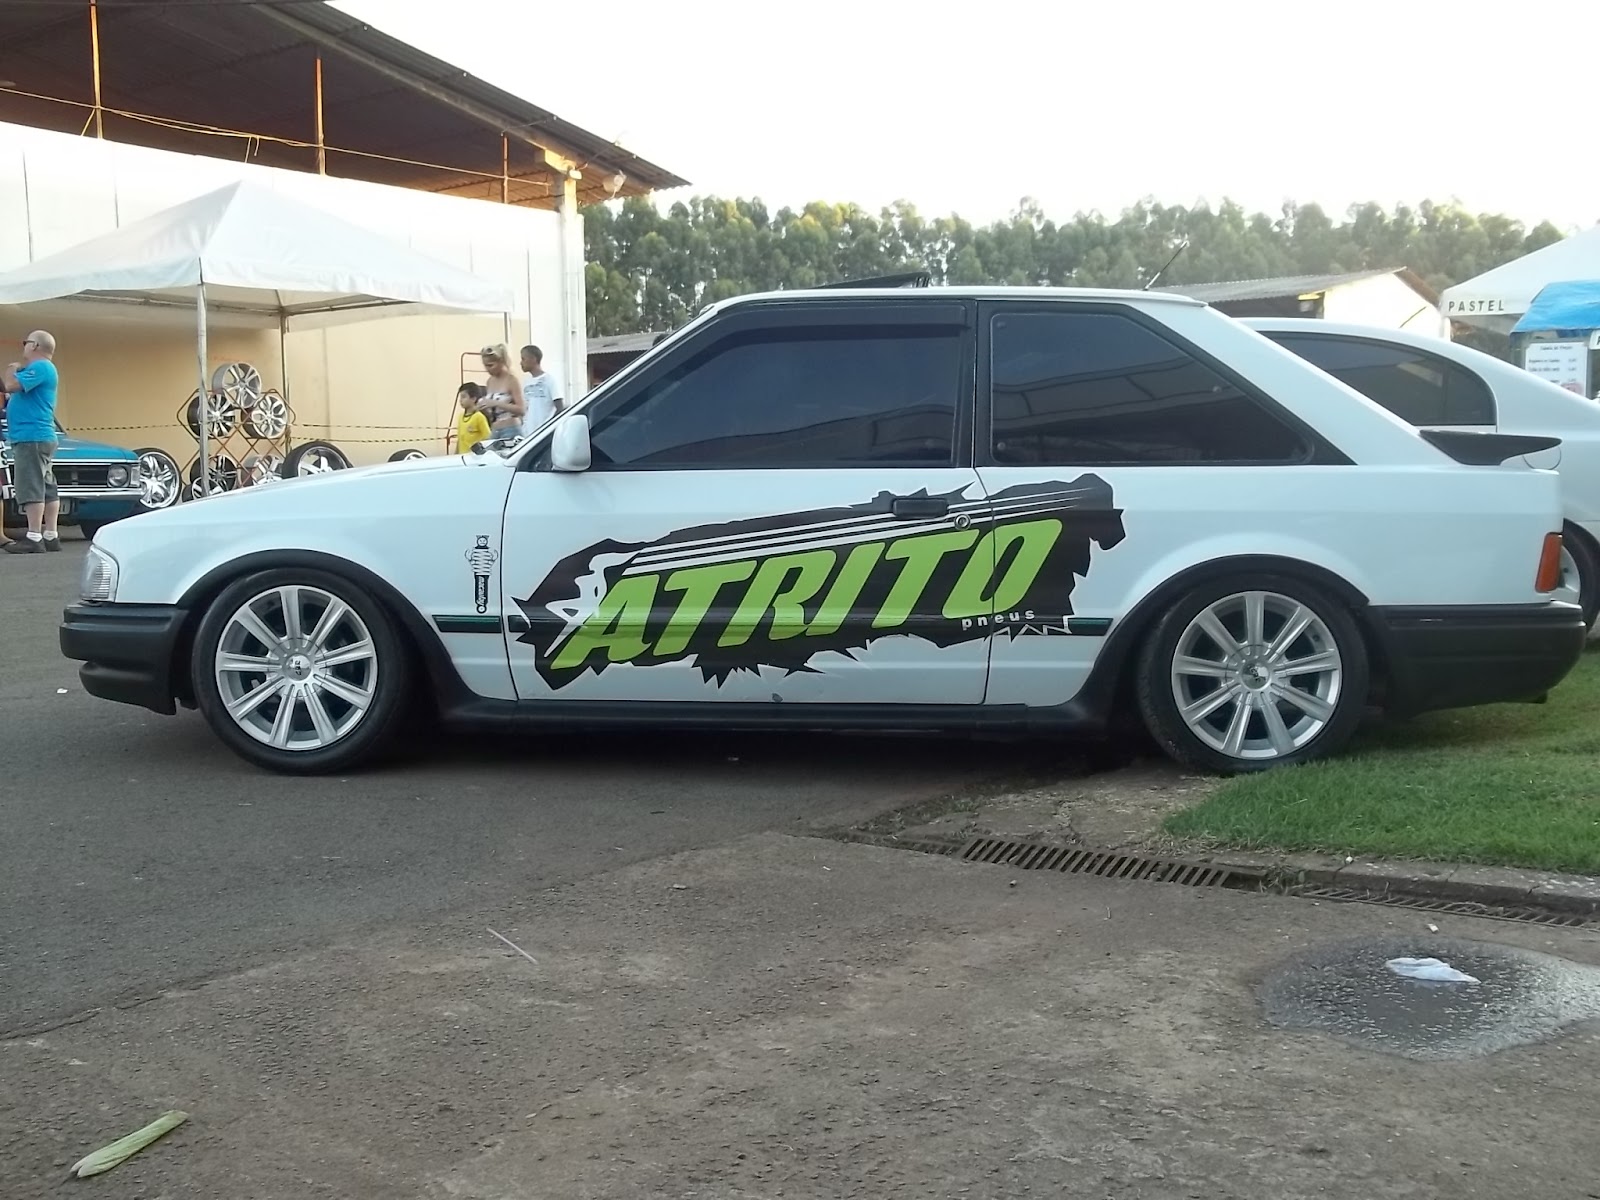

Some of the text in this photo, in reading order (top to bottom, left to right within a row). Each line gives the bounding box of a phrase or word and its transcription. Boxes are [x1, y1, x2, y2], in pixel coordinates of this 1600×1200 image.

[1448, 299, 1505, 312] PASTEL
[550, 518, 1063, 670] ATRITO
[961, 609, 1035, 631] pneus
